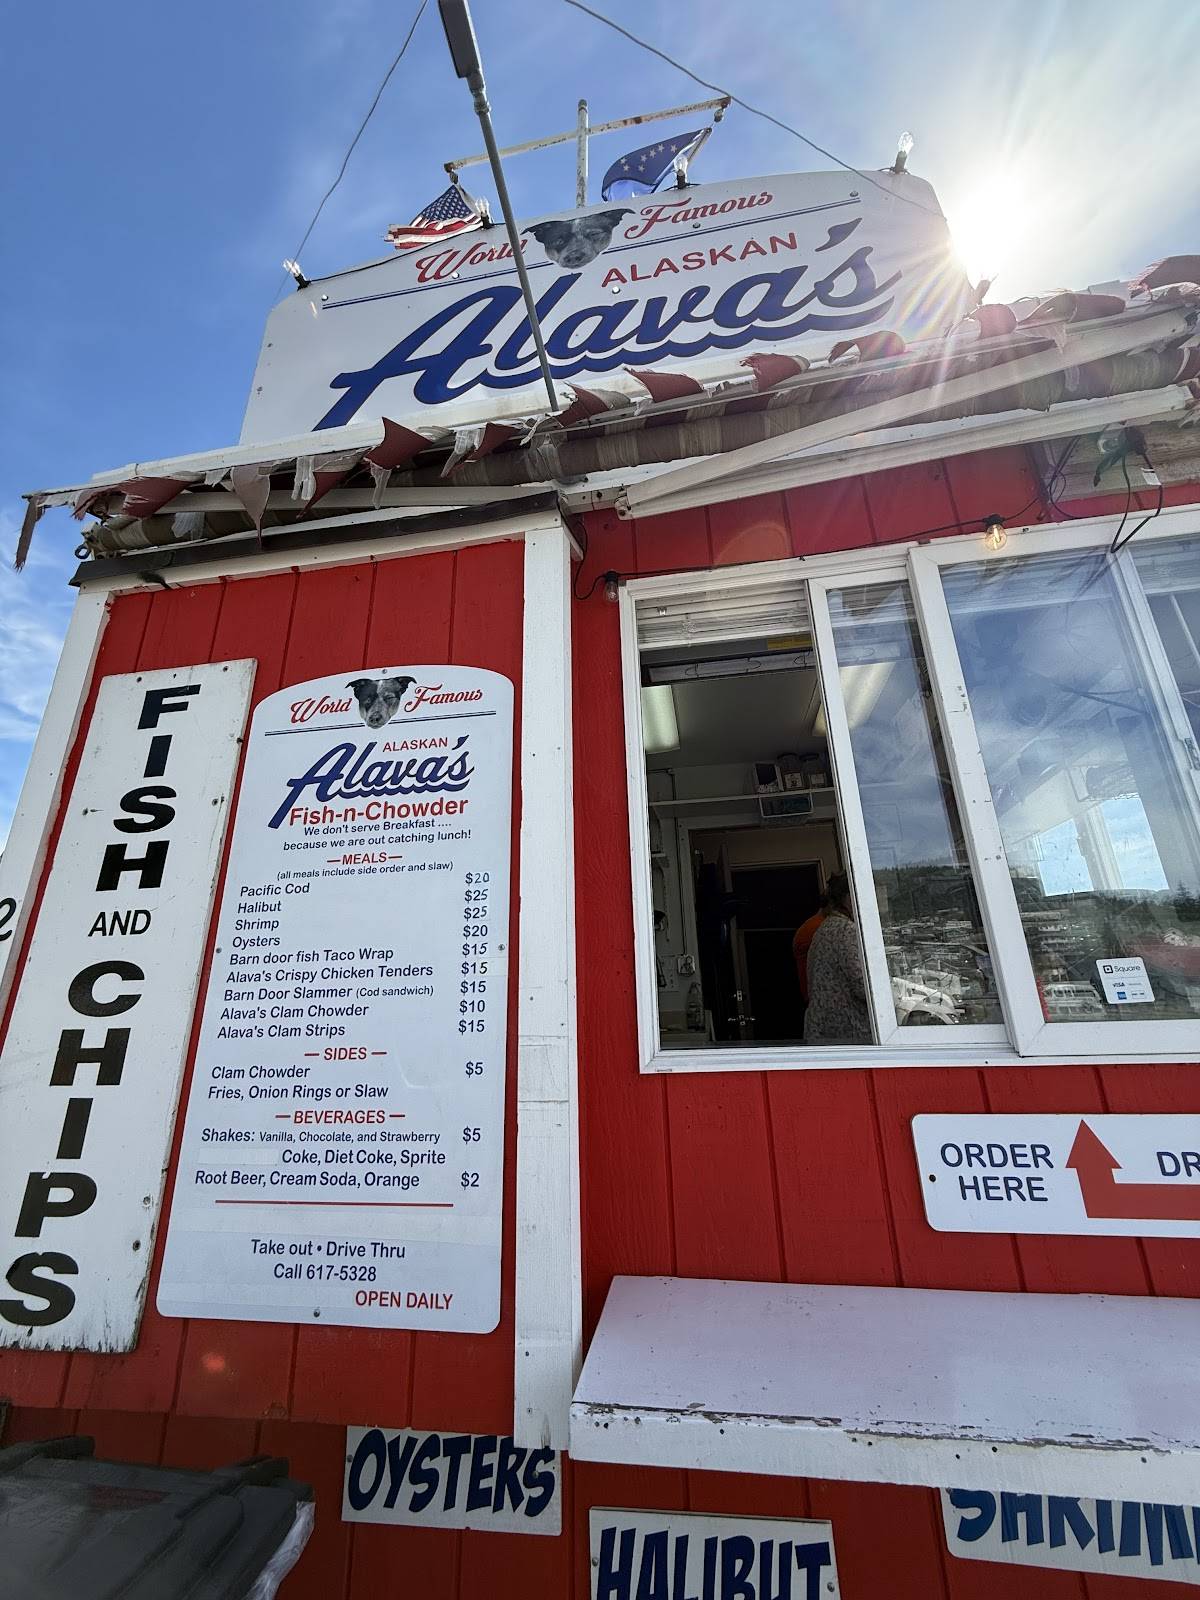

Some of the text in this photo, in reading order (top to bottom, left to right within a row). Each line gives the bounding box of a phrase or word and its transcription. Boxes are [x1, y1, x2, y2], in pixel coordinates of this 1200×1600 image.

[414, 188, 773, 283] World Famous
[600, 231, 798, 289] ALASKAN
[313, 217, 902, 432] Alava's
[291, 683, 482, 724] World Famous
[382, 736, 448, 753] ALASKAN
[95, 684, 201, 891] FISH
[267, 735, 474, 829] Alava's
[289, 797, 469, 826] Fish-n-Chowder
[304, 826, 320, 836] We
[322, 824, 349, 835] don't
[351, 824, 380, 833] serve
[383, 818, 435, 831] Breakfast
[283, 829, 471, 851] because we are out catching lunch!
[277, 861, 454, 881] (all meals include side order and slaw)
[240, 871, 490, 897] Pacific Cod $20
[237, 888, 489, 914] Halibut $25
[87, 908, 152, 937] AND
[235, 905, 488, 932] Shrimp $25
[232, 924, 488, 951] Oysters $20
[229, 942, 488, 966] Barn door fish Taco Wrap $15
[226, 961, 488, 984] Alava's Crispy Chicken Tenders $15
[1113, 964, 1141, 973] Square
[224, 980, 486, 1001] Barn Door Slammer (Cod sandwich) $15
[220, 999, 486, 1020] Alava's Clam Chowder $10
[217, 1019, 485, 1039] Alava's Clam Strips $15
[323, 1047, 367, 1061] SIDES
[211, 1061, 483, 1079] Clam Chowder $5
[208, 1084, 389, 1102] Fries, Onion Rings or Slaw
[293, 1110, 386, 1124] BEVERAGES
[1, 960, 145, 1327] CHIPS
[201, 1126, 481, 1145] Shakes: Vanilla, Chocolate, and Strawberry $5
[282, 1149, 446, 1168] Coke, Diet Coke, Sprite
[940, 1143, 1054, 1168] ORDER
[195, 1170, 480, 1191] Root Beer, Cream Soda, Orange $2
[958, 1175, 1048, 1202] HERE
[251, 1239, 406, 1259] Take out Drive Thru
[273, 1263, 377, 1282] Call 617-5328
[355, 1290, 453, 1310] OPEN DAILY
[348, 1428, 556, 1517] OYSTERS
[949, 1488, 1200, 1566] SHRIM
[596, 1526, 831, 1600] HALIBUT
